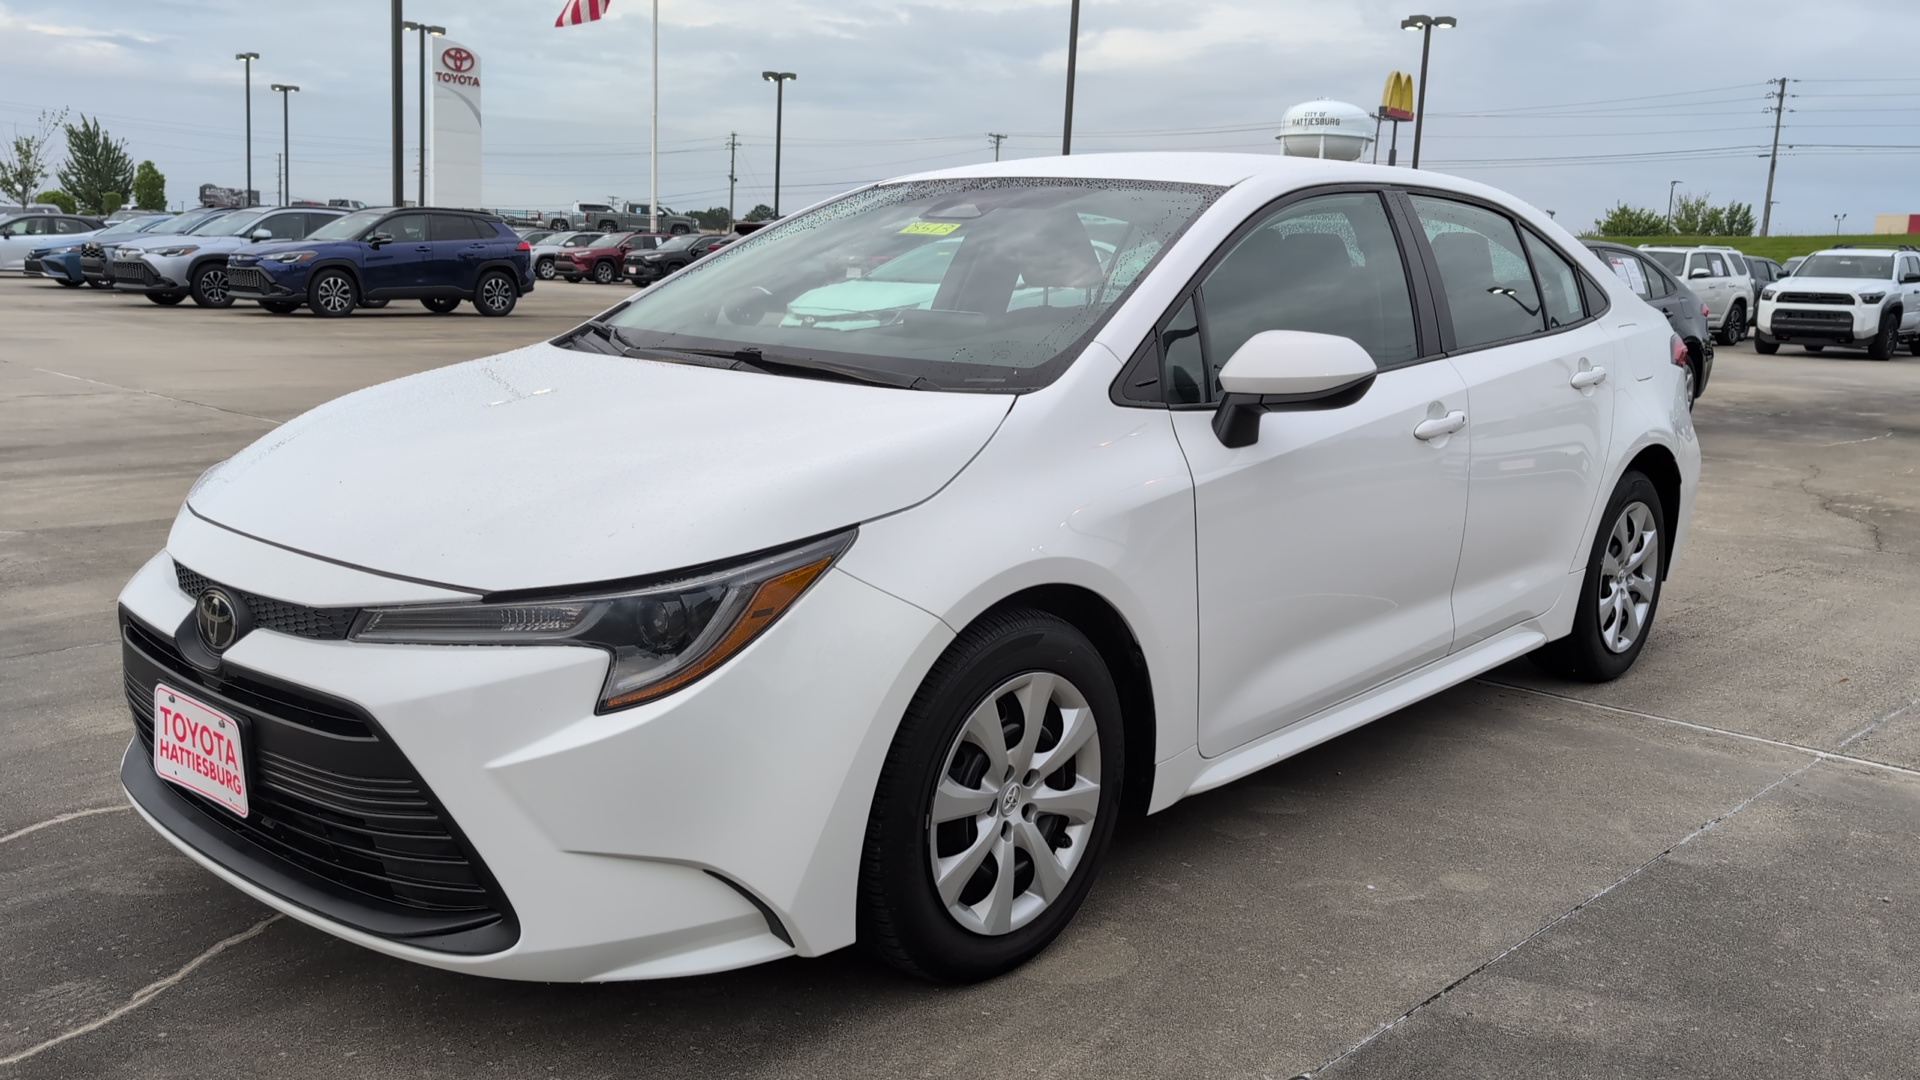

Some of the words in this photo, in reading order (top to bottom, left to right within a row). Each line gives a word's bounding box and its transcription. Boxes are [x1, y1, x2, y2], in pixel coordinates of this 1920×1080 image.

[435, 71, 480, 87] TOYOTA
[1292, 117, 1341, 127] HATTIESBURG
[160, 705, 238, 771] TOYOTA
[160, 738, 242, 795] HATTIESBURG
